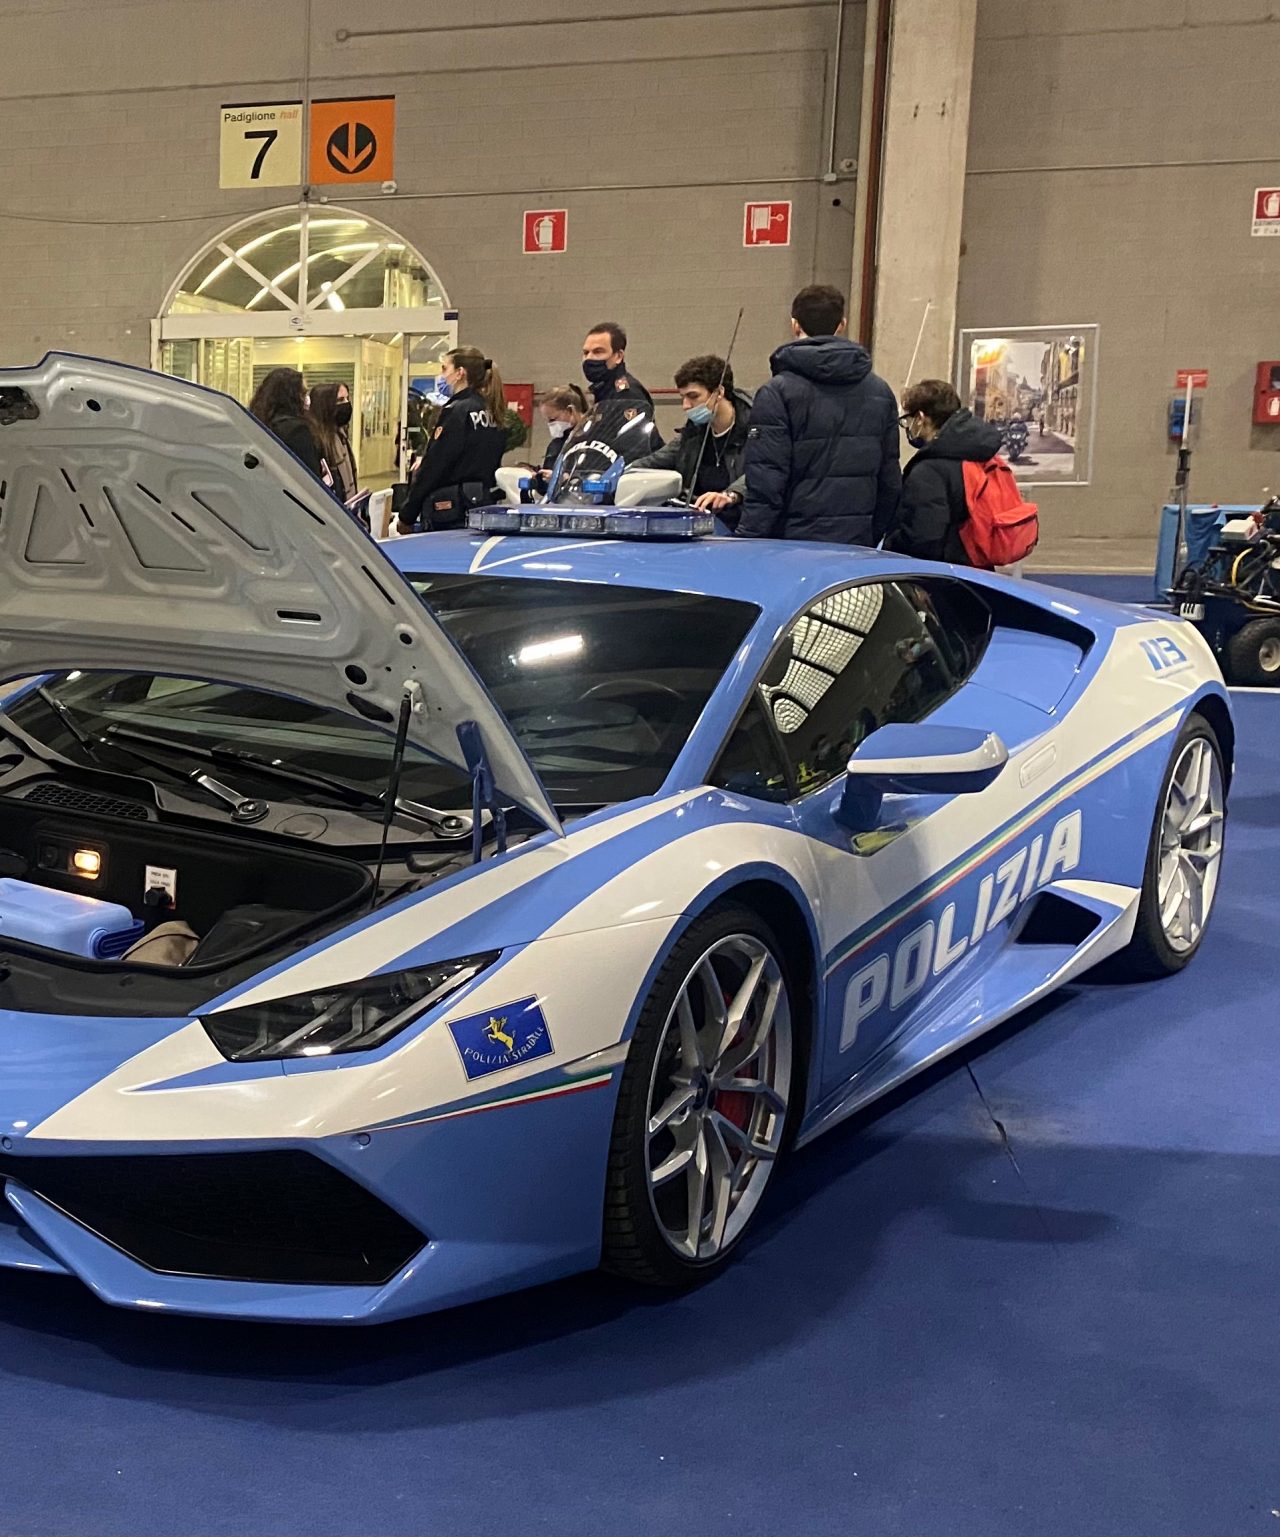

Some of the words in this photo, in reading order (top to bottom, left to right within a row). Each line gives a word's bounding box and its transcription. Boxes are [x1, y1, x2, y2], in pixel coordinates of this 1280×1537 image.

[224, 111, 276, 124] Padiglione
[280, 110, 299, 120] hall
[244, 130, 278, 180] 7
[1139, 637, 1187, 671] 113
[839, 809, 1082, 1053] POLIZIA
[464, 1047, 509, 1064] POLIZIA
